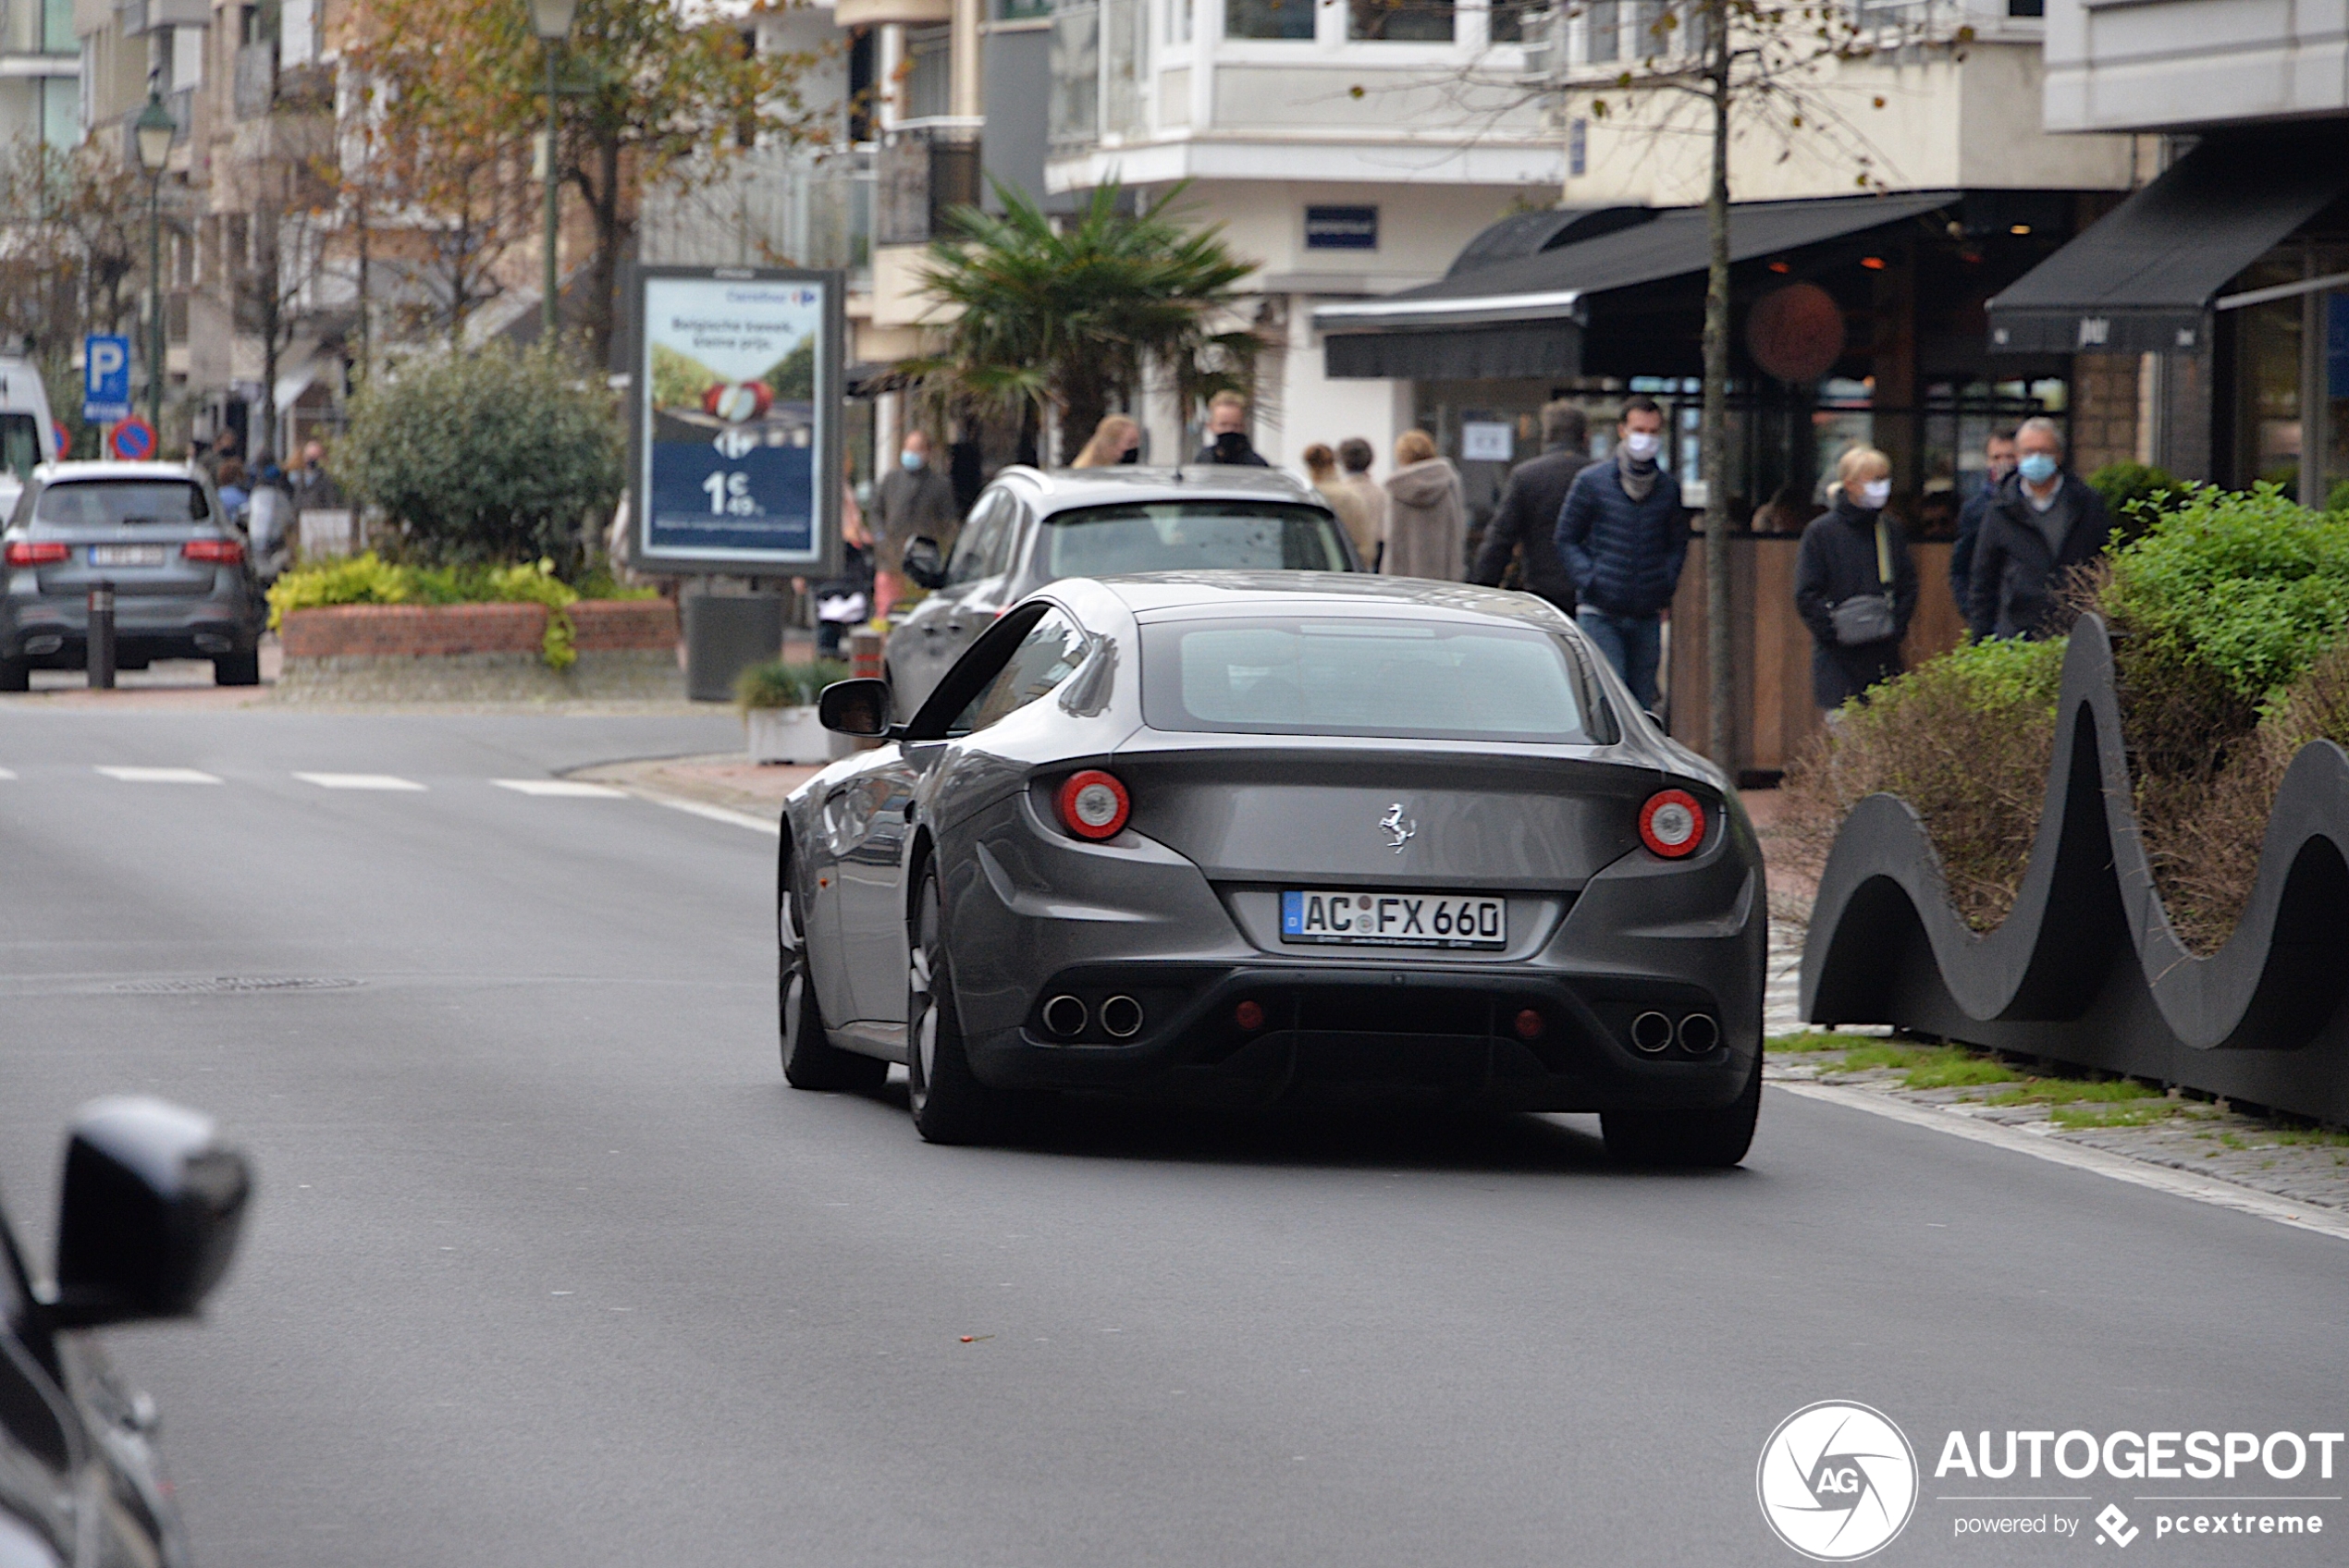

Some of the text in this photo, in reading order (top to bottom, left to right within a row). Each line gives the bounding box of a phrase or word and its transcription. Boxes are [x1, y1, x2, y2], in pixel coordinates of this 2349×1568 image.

[90, 342, 123, 392] P
[1305, 896, 1499, 937] AC FX 660
